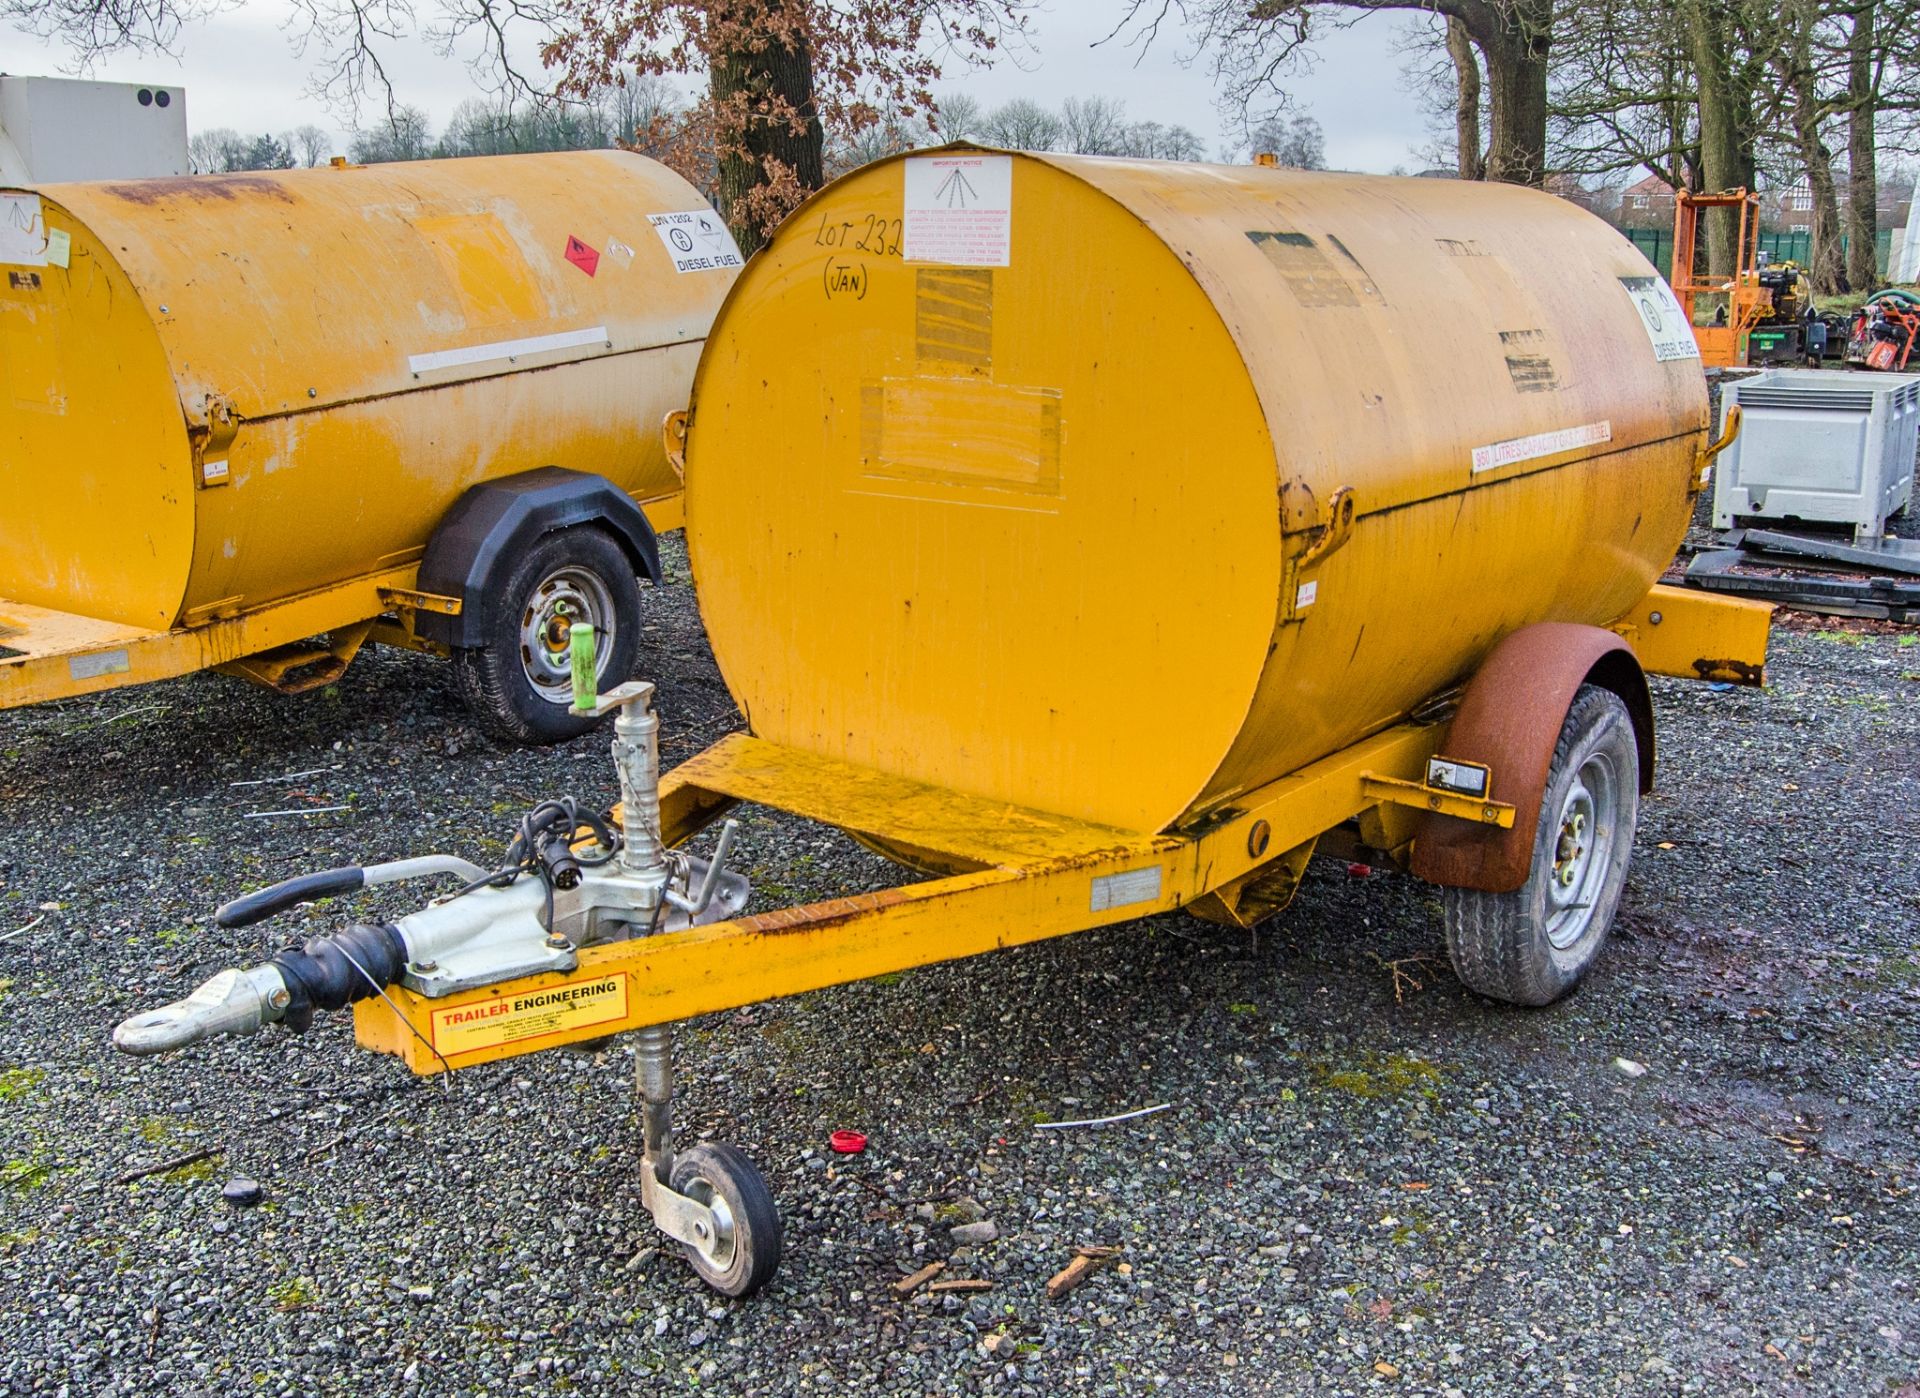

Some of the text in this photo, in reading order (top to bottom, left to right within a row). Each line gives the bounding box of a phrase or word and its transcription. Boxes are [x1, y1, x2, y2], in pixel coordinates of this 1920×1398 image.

[670, 214, 692, 224] 1202
[815, 212, 904, 258] LOT 232
[678, 254, 740, 272] DIESEL FUEL
[824, 256, 868, 300] (JAN)
[1655, 341, 1697, 358] DIESEL FUEL
[1476, 450, 1490, 467] 950
[1494, 442, 1521, 462] LITRES
[442, 1004, 509, 1026] TRAILER
[514, 981, 616, 1012] ENGINEERING
